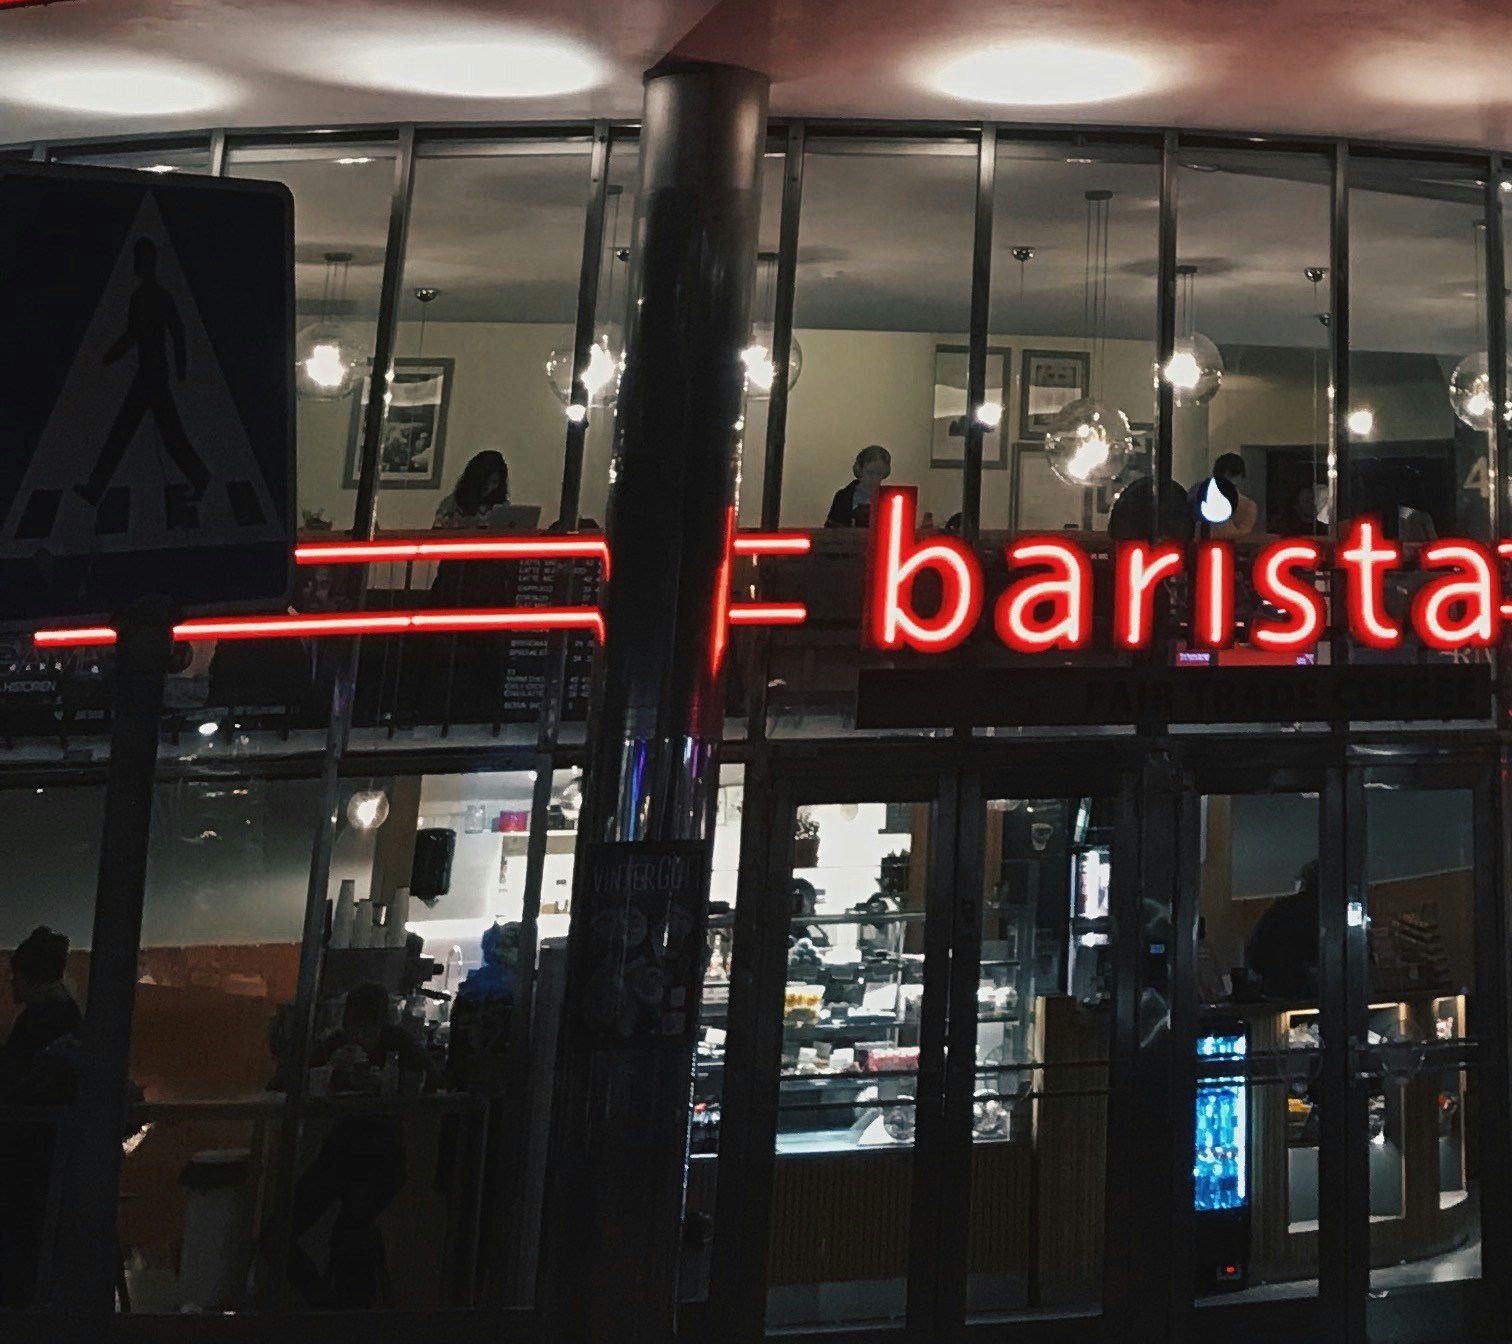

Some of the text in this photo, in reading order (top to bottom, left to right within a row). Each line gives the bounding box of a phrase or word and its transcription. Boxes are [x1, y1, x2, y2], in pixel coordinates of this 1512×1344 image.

[867, 484, 1496, 657] barista
[1085, 675, 1476, 713] FAIR TRADE COFFEE
